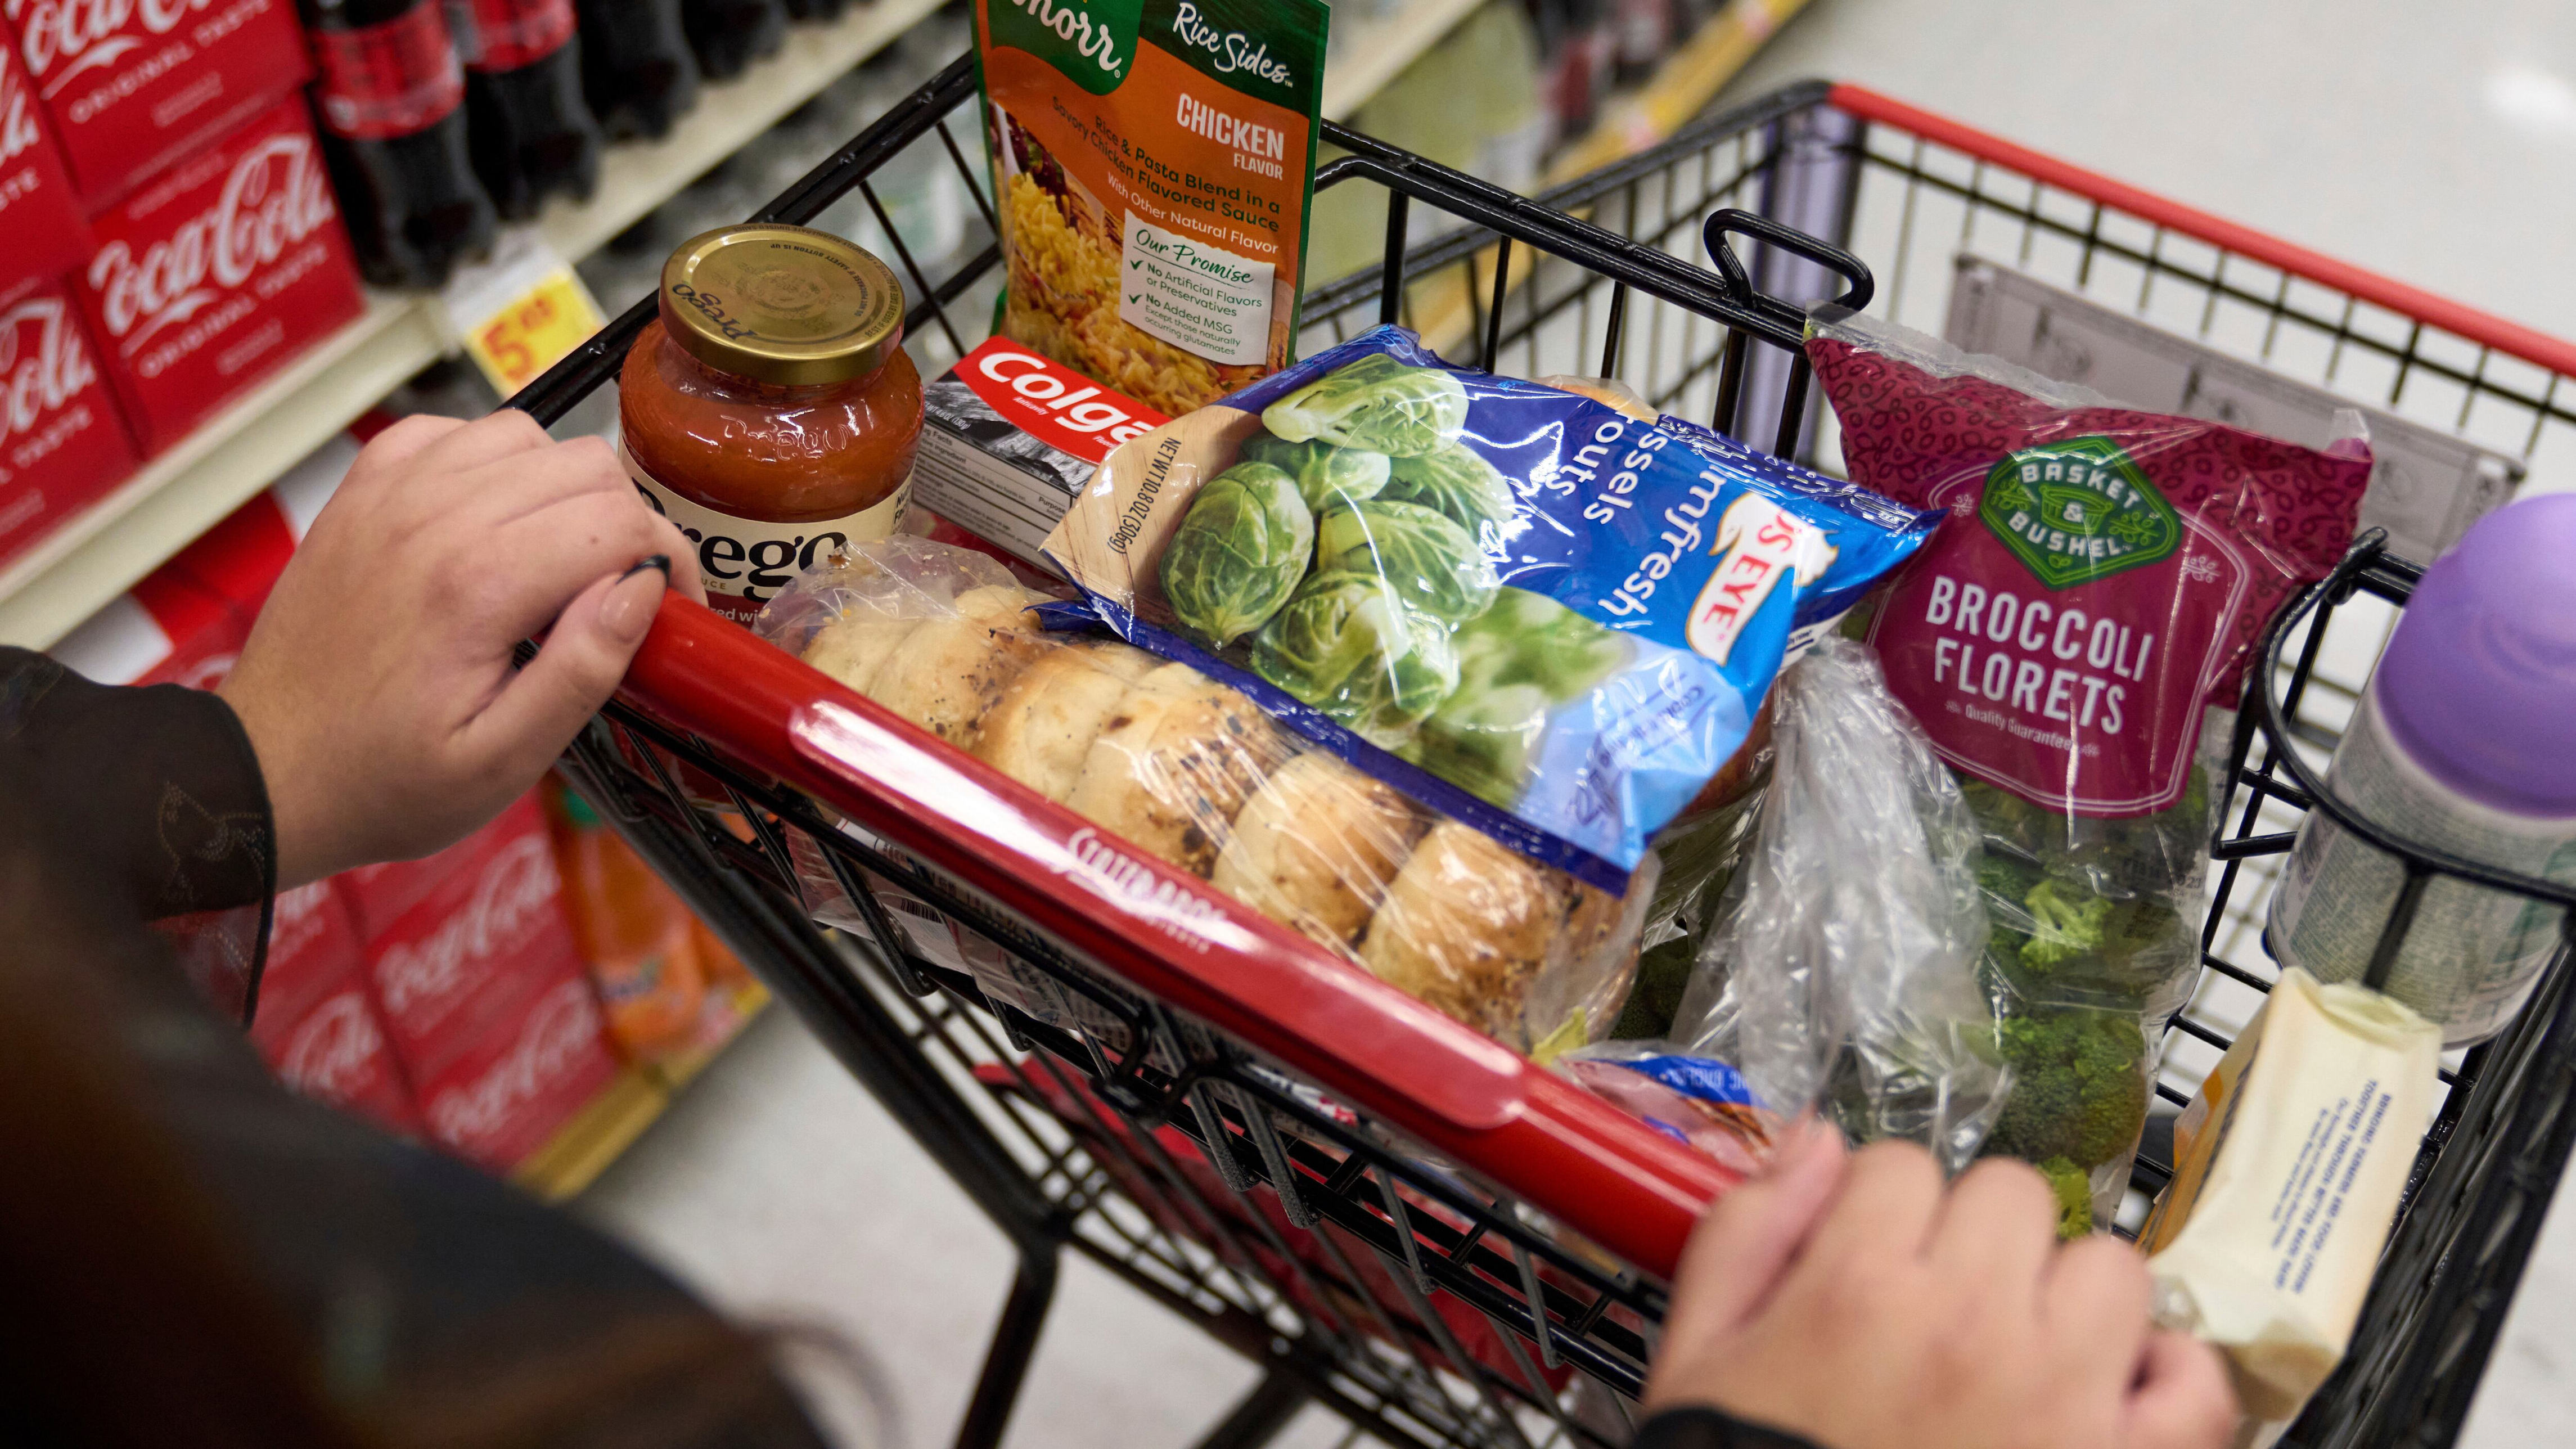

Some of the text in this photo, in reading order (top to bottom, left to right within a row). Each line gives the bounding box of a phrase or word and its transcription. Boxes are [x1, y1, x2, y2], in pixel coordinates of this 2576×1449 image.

[1014, 0, 1122, 71] norr
[1173, 3, 1290, 84] Rice Sides
[1177, 94, 1284, 161] CHICKEN
[1052, 96, 1280, 233] Savory Chicken Flavored Sauce
[1095, 115, 1280, 214] Rice & Pasta Blend in a
[1233, 152, 1283, 181] FLAVOR
[1107, 172, 1279, 255] With Other Natural Flavor
[793, 245, 825, 257] BUTTON
[1136, 230, 1254, 284] Our Promise
[1146, 277, 1237, 317] or Preservatives
[1148, 263, 1263, 308] No Artificial Flavors
[672, 284, 758, 340] Prego
[1145, 305, 1241, 347] Except those naturally
[1145, 317, 1235, 355] occurring glutamates
[1146, 293, 1233, 334] No Added MSG
[1012, 396, 1050, 415] Anticavity
[1038, 495, 1066, 515] Purpose
[1107, 437, 1182, 554] NET WT 10.8 OZ (306g)
[2021, 462, 2141, 509] BASKET
[1598, 464, 1730, 617] mfresh
[2008, 510, 2123, 558] BUSHEL
[701, 578, 727, 590] UCE
[1703, 554, 1771, 630] EYE
[1926, 576, 2153, 682] BROCCOLI
[1933, 637, 2125, 735] FLORETS
[1966, 705, 2006, 731] Quality
